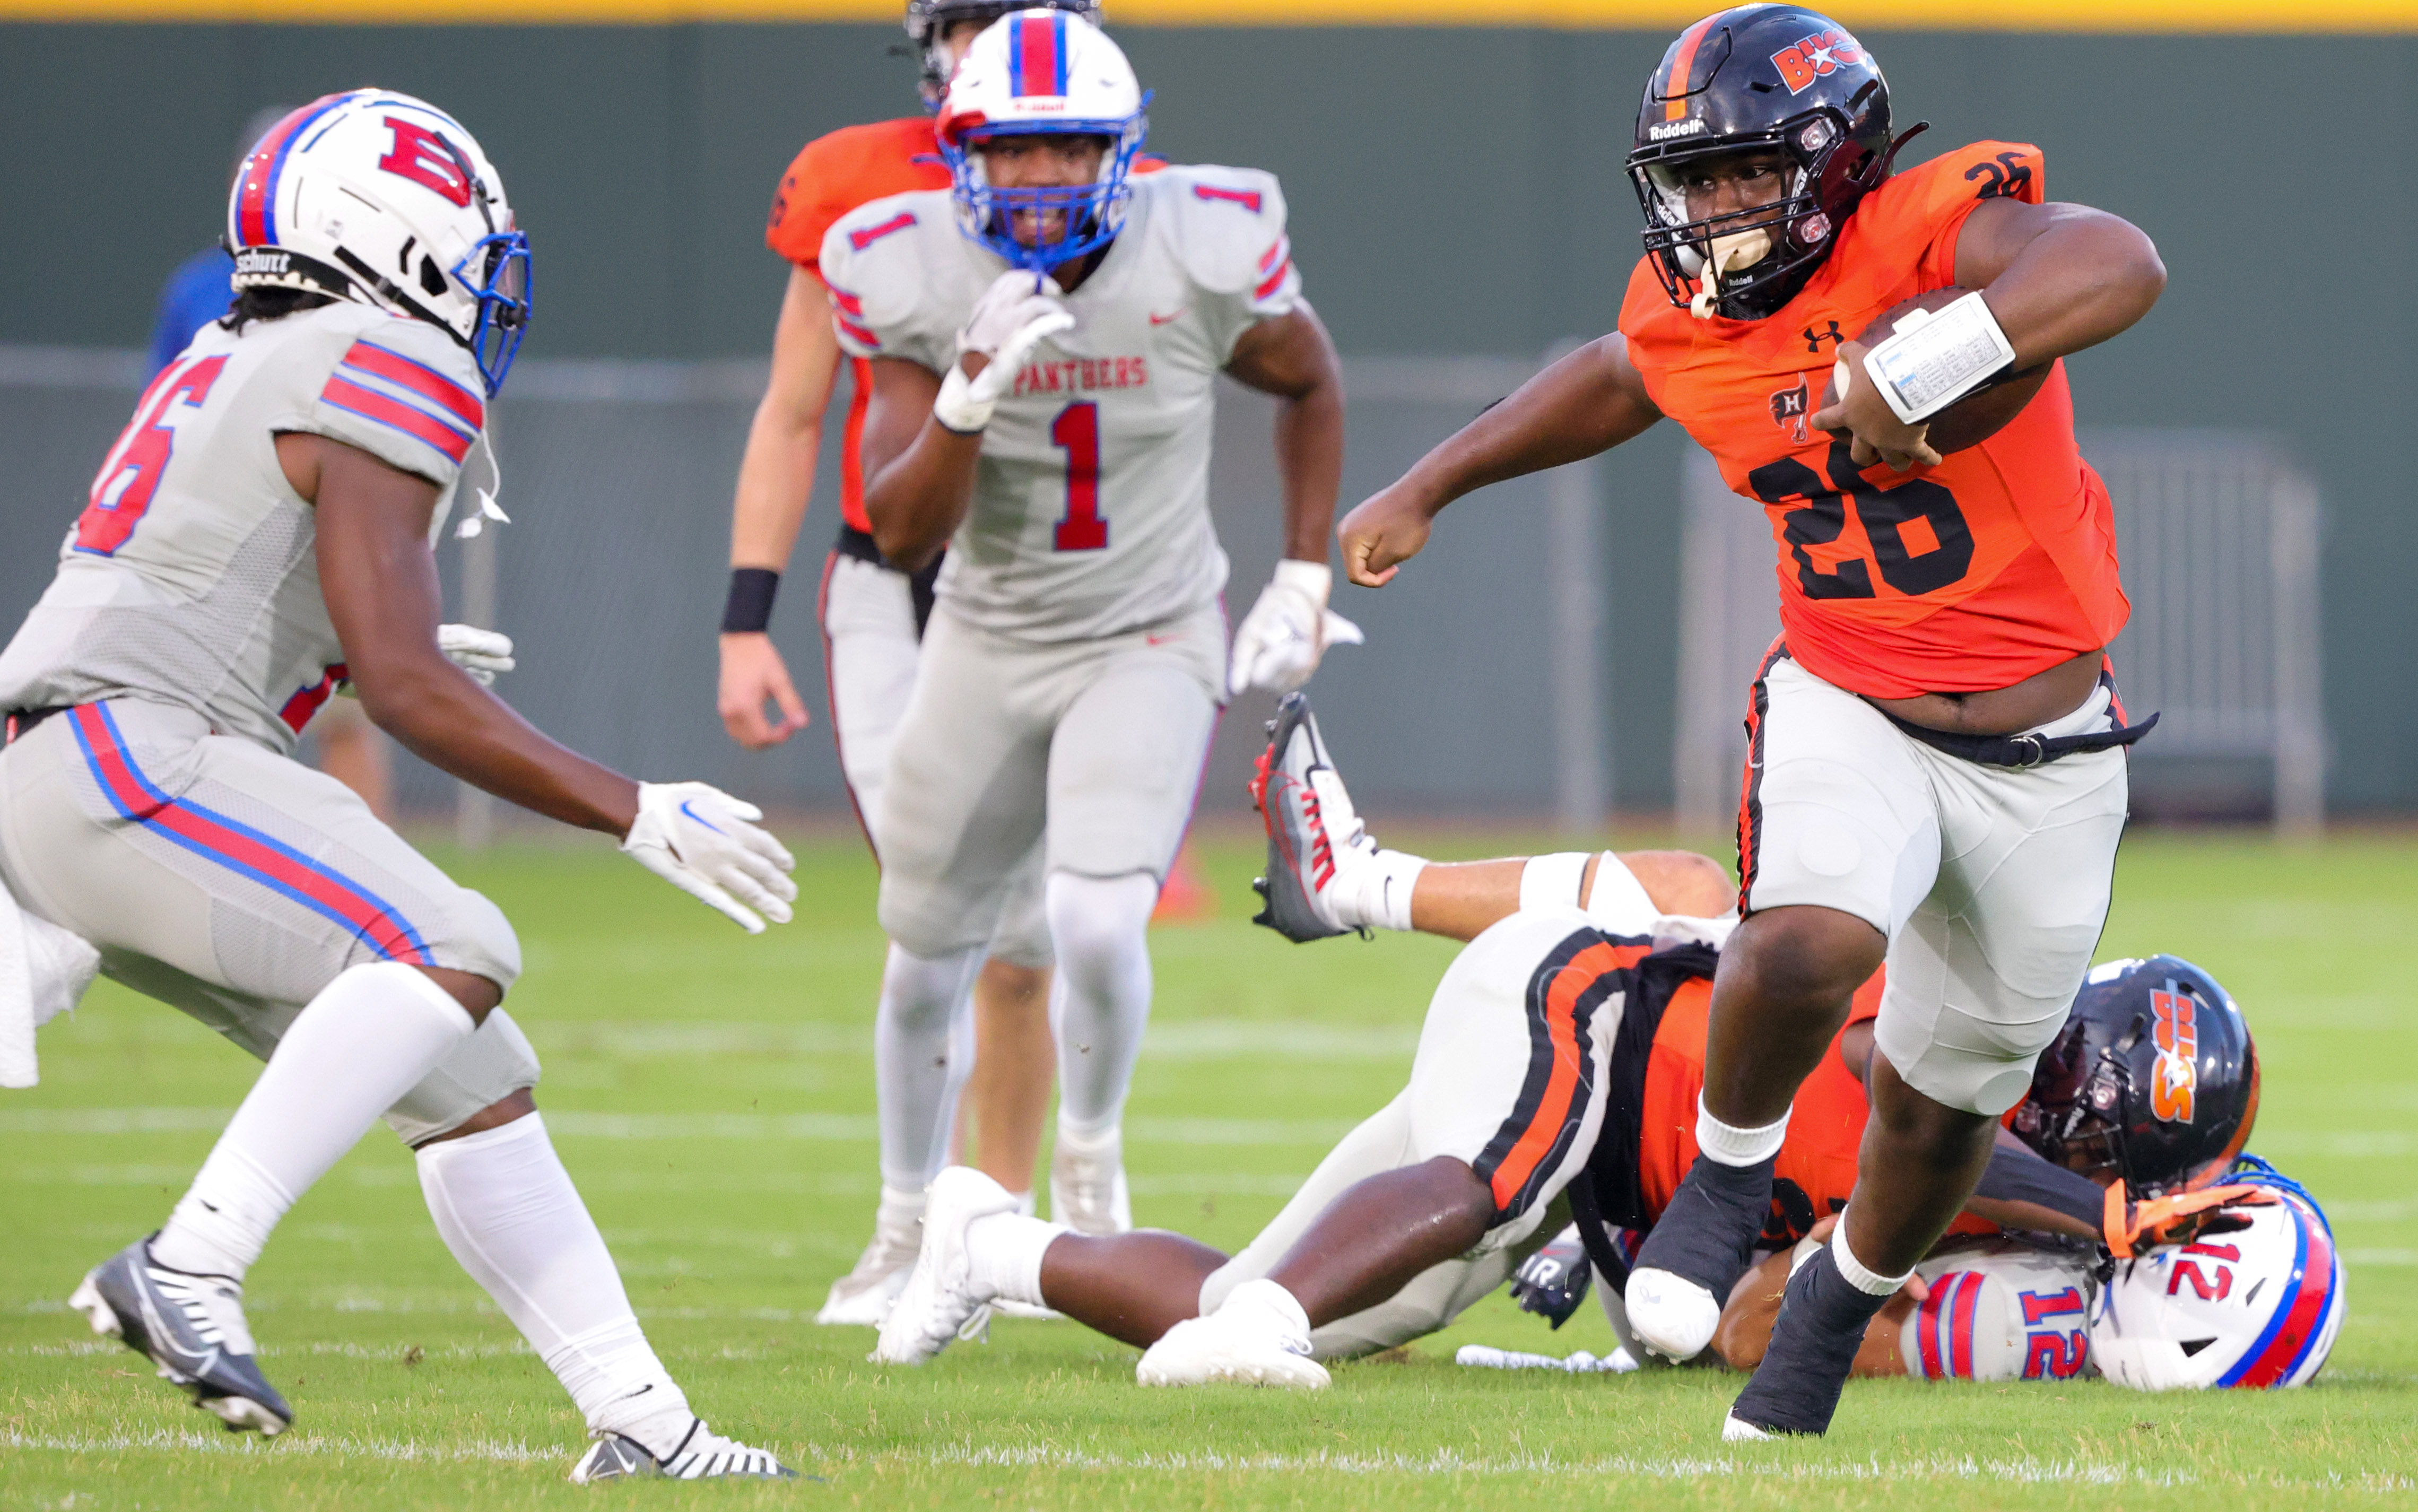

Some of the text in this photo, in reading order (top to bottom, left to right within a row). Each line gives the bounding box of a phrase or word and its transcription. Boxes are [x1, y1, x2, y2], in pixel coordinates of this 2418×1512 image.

[1650, 118, 1700, 142] Riddell
[1964, 152, 2031, 199] 26
[1191, 183, 1263, 214] 1
[848, 211, 919, 251] 1
[1013, 354, 1149, 397] PANTHERS
[1783, 393, 1801, 414] H
[1050, 398, 1109, 551] 1
[1749, 440, 1976, 599] 26
[2167, 1243, 2241, 1301] 12
[2019, 1286, 2089, 1380] 12
